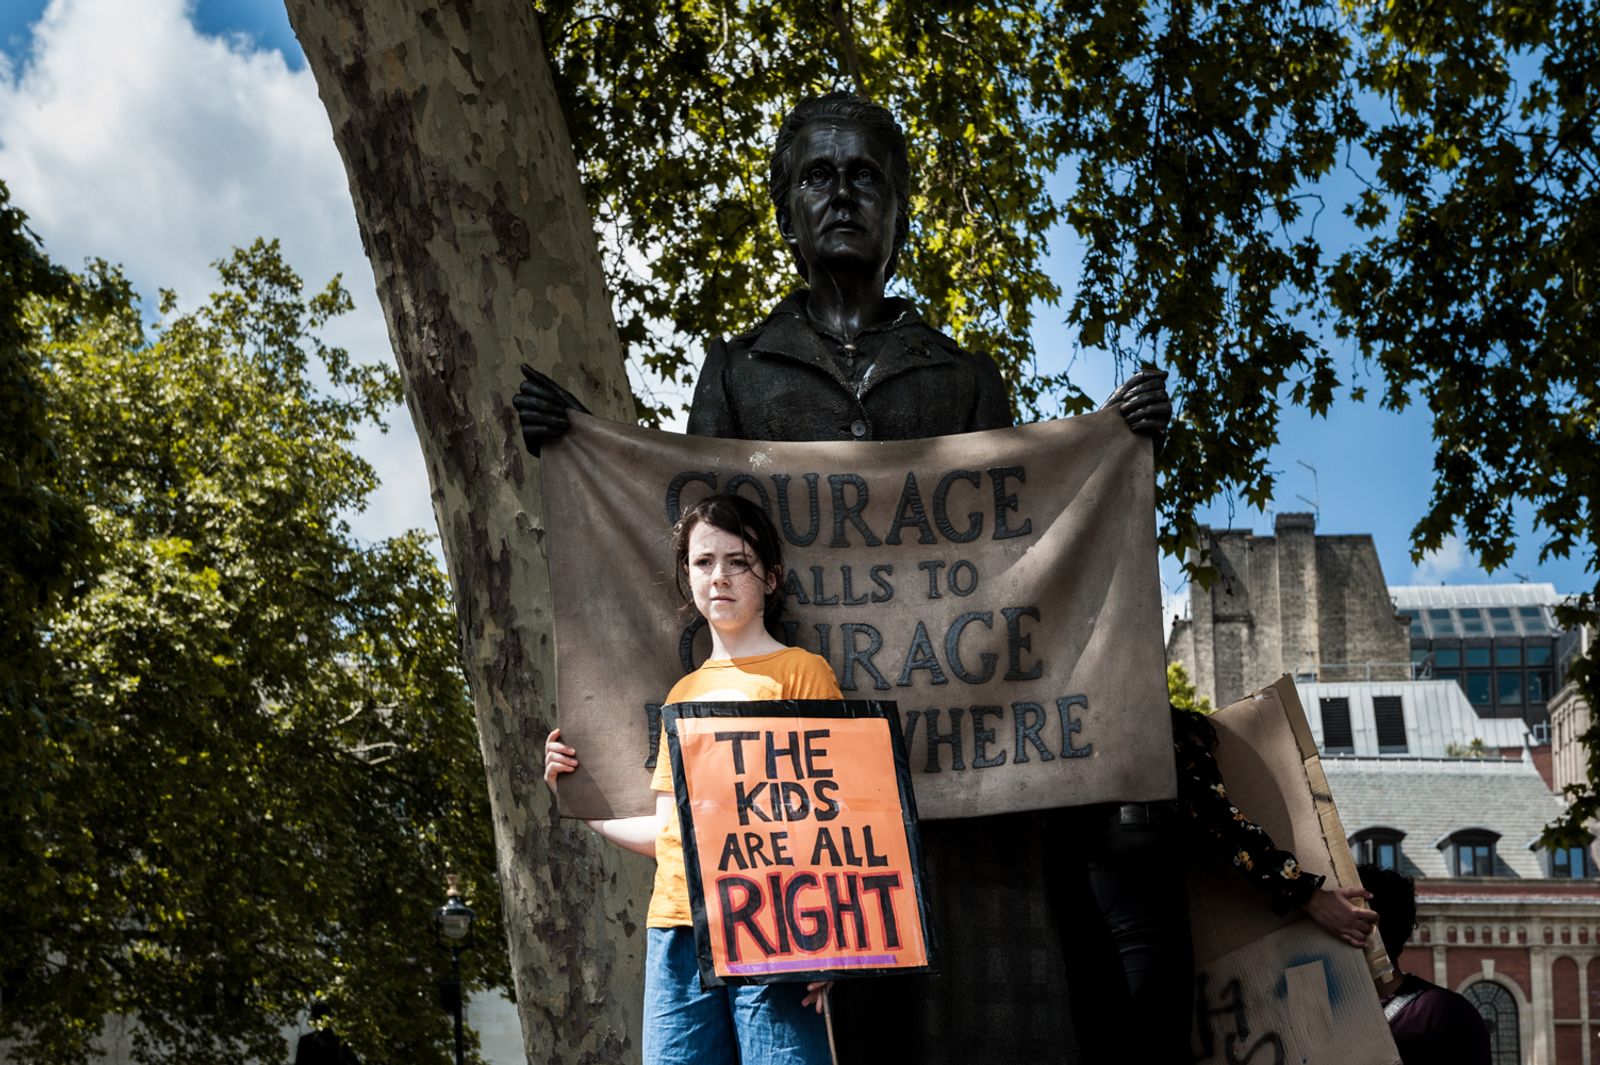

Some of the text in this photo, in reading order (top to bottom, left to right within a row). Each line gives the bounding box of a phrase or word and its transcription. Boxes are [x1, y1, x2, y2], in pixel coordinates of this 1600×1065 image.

[783, 559, 979, 606] ALLS TO
[679, 606, 1044, 691] RAGE
[714, 729, 834, 780] THE
[734, 779, 840, 826] KIDS
[717, 825, 889, 871] ARE ALL
[714, 871, 904, 964] RIGHT
